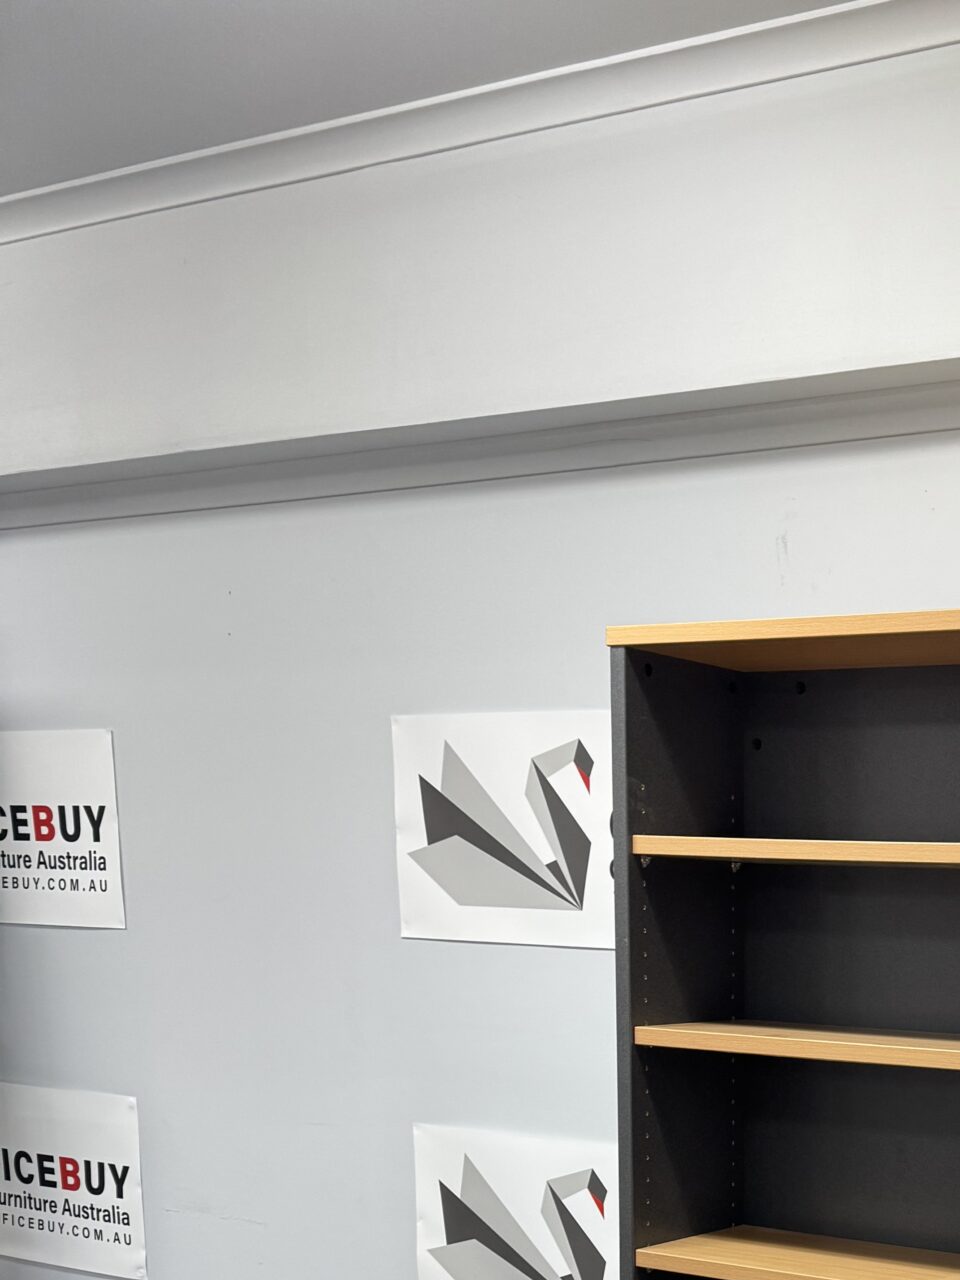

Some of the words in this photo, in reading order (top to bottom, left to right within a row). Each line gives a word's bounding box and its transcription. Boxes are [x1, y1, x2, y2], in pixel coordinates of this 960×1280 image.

[0, 850, 32, 869] ture
[37, 850, 107, 871] Australia
[2, 876, 108, 893] EBUY.COM.AU
[1, 1148, 130, 1199] ICEBUY
[62, 1198, 130, 1226] Australia
[2, 1213, 132, 1246] FICEBUY.COM.AU
